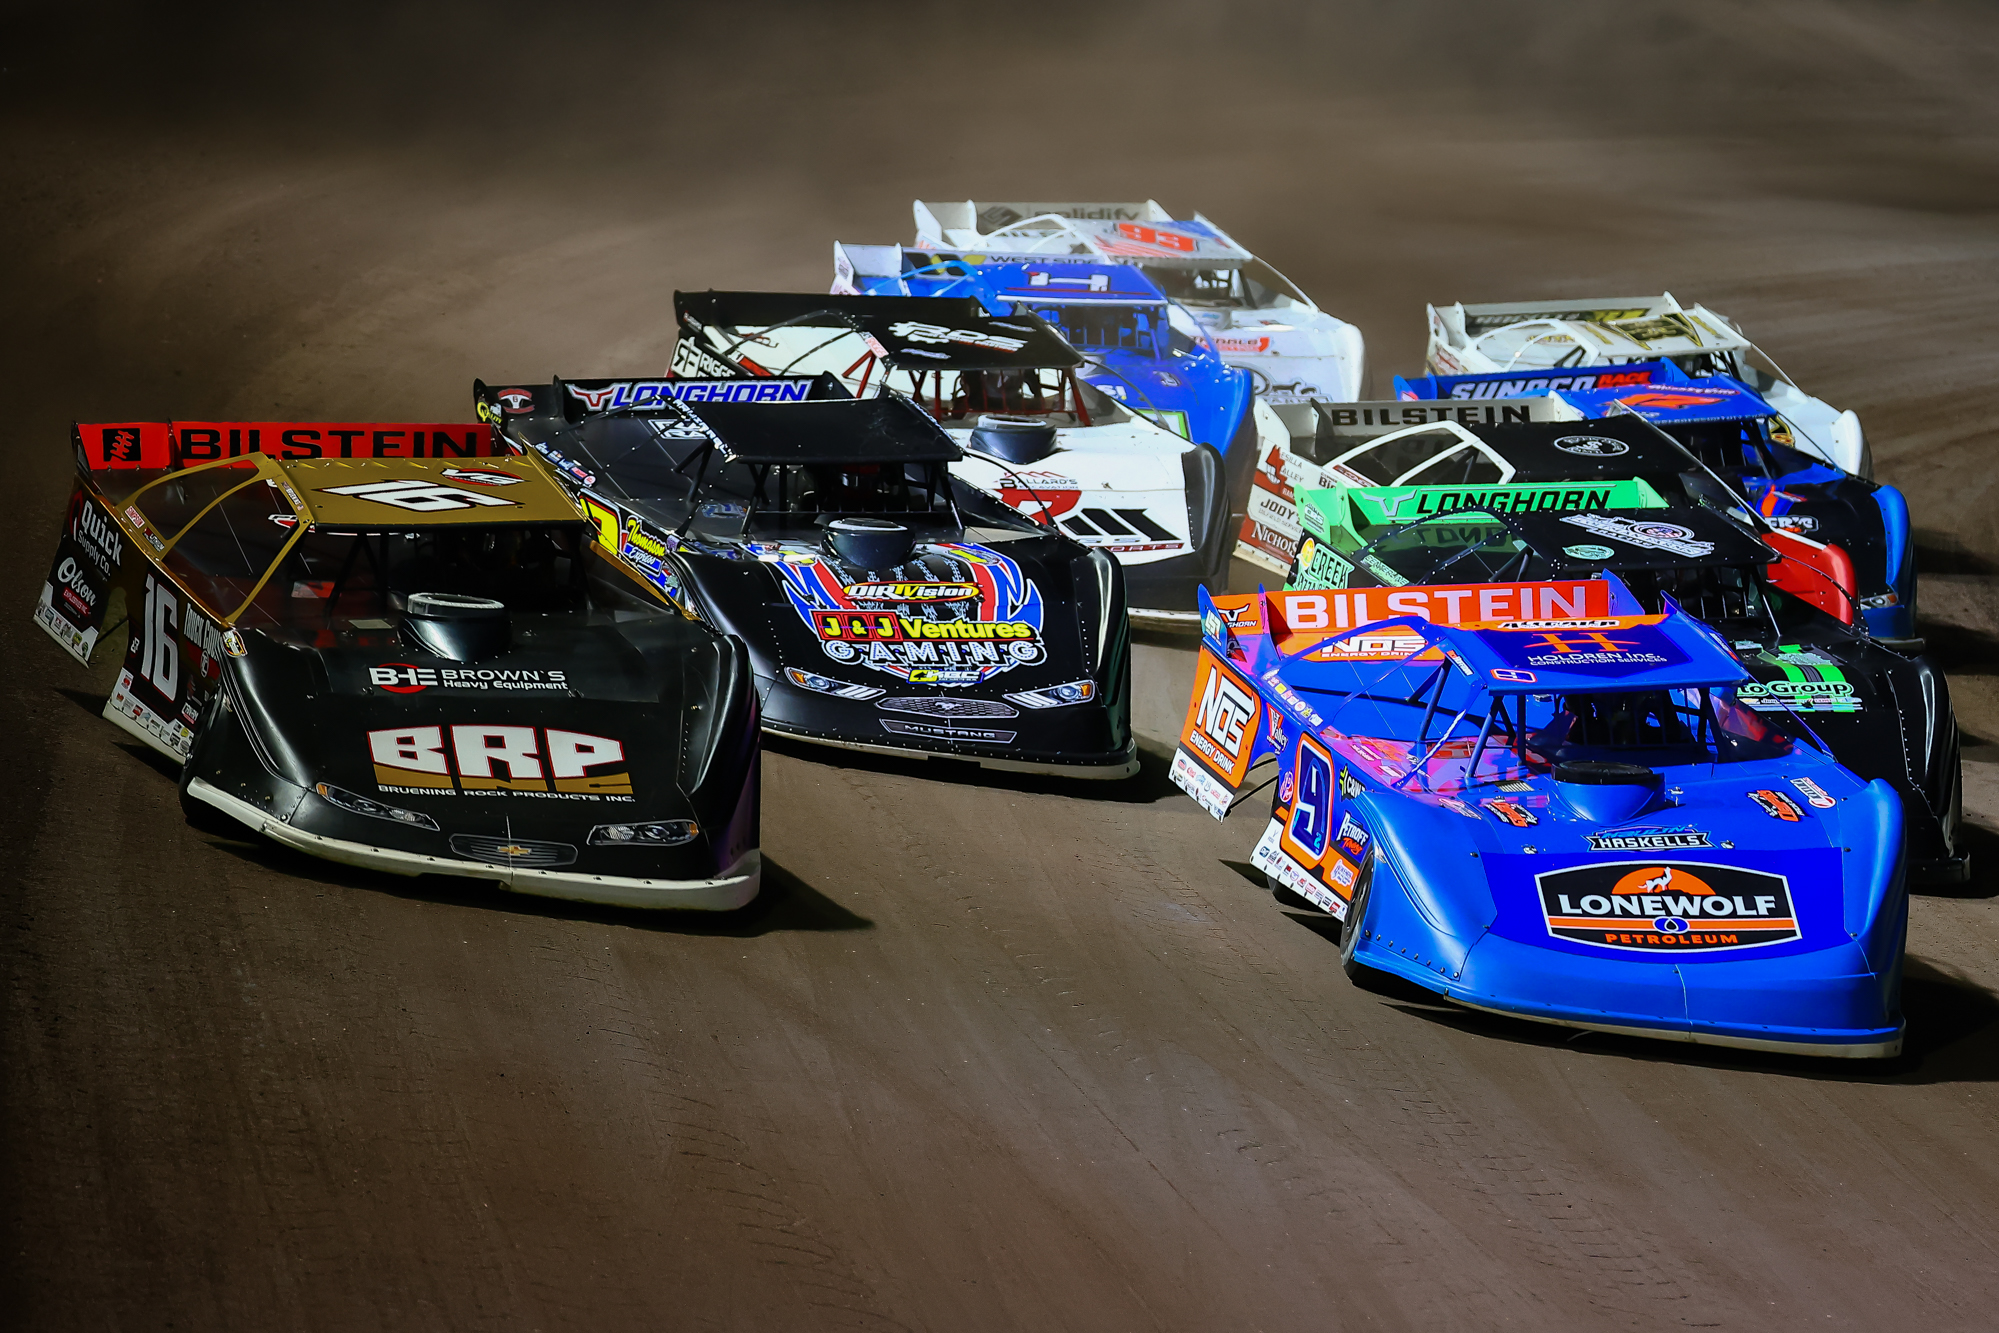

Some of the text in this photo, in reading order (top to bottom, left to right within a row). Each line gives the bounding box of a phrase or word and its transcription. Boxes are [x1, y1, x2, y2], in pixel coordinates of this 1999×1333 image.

[613, 379, 814, 412] LONGHORN
[1332, 405, 1531, 426] BILSTEIN
[180, 428, 478, 460] BILSTEIN
[1416, 489, 1611, 514] LONGHORN
[81, 500, 123, 566] Quick
[1284, 586, 1586, 629] BILSTEIN
[140, 572, 178, 702] 16
[824, 617, 842, 636] J
[876, 616, 895, 636] J
[899, 618, 1032, 639] Ventures
[825, 641, 1038, 664] GAMING
[1322, 636, 1428, 653] NOS
[1527, 652, 1661, 662] HOLDREN Inc.
[1529, 656, 1668, 667] CONSTRUCTION SERVICES
[443, 680, 569, 691] Heavy Equipment
[1770, 682, 1849, 696] Group
[1196, 667, 1256, 758] NOS
[903, 725, 997, 739] MUSTANG
[367, 724, 626, 780] BRP
[1189, 731, 1236, 776] ENERGY DRINK
[378, 785, 636, 803] BRUENING ROCK PRODUCTS INC.
[1336, 813, 1370, 847] PETROFF
[1599, 834, 1700, 849] HASKELLS
[1557, 893, 1776, 917] LONEWOLF
[1604, 932, 1739, 945] PETROLEUM
